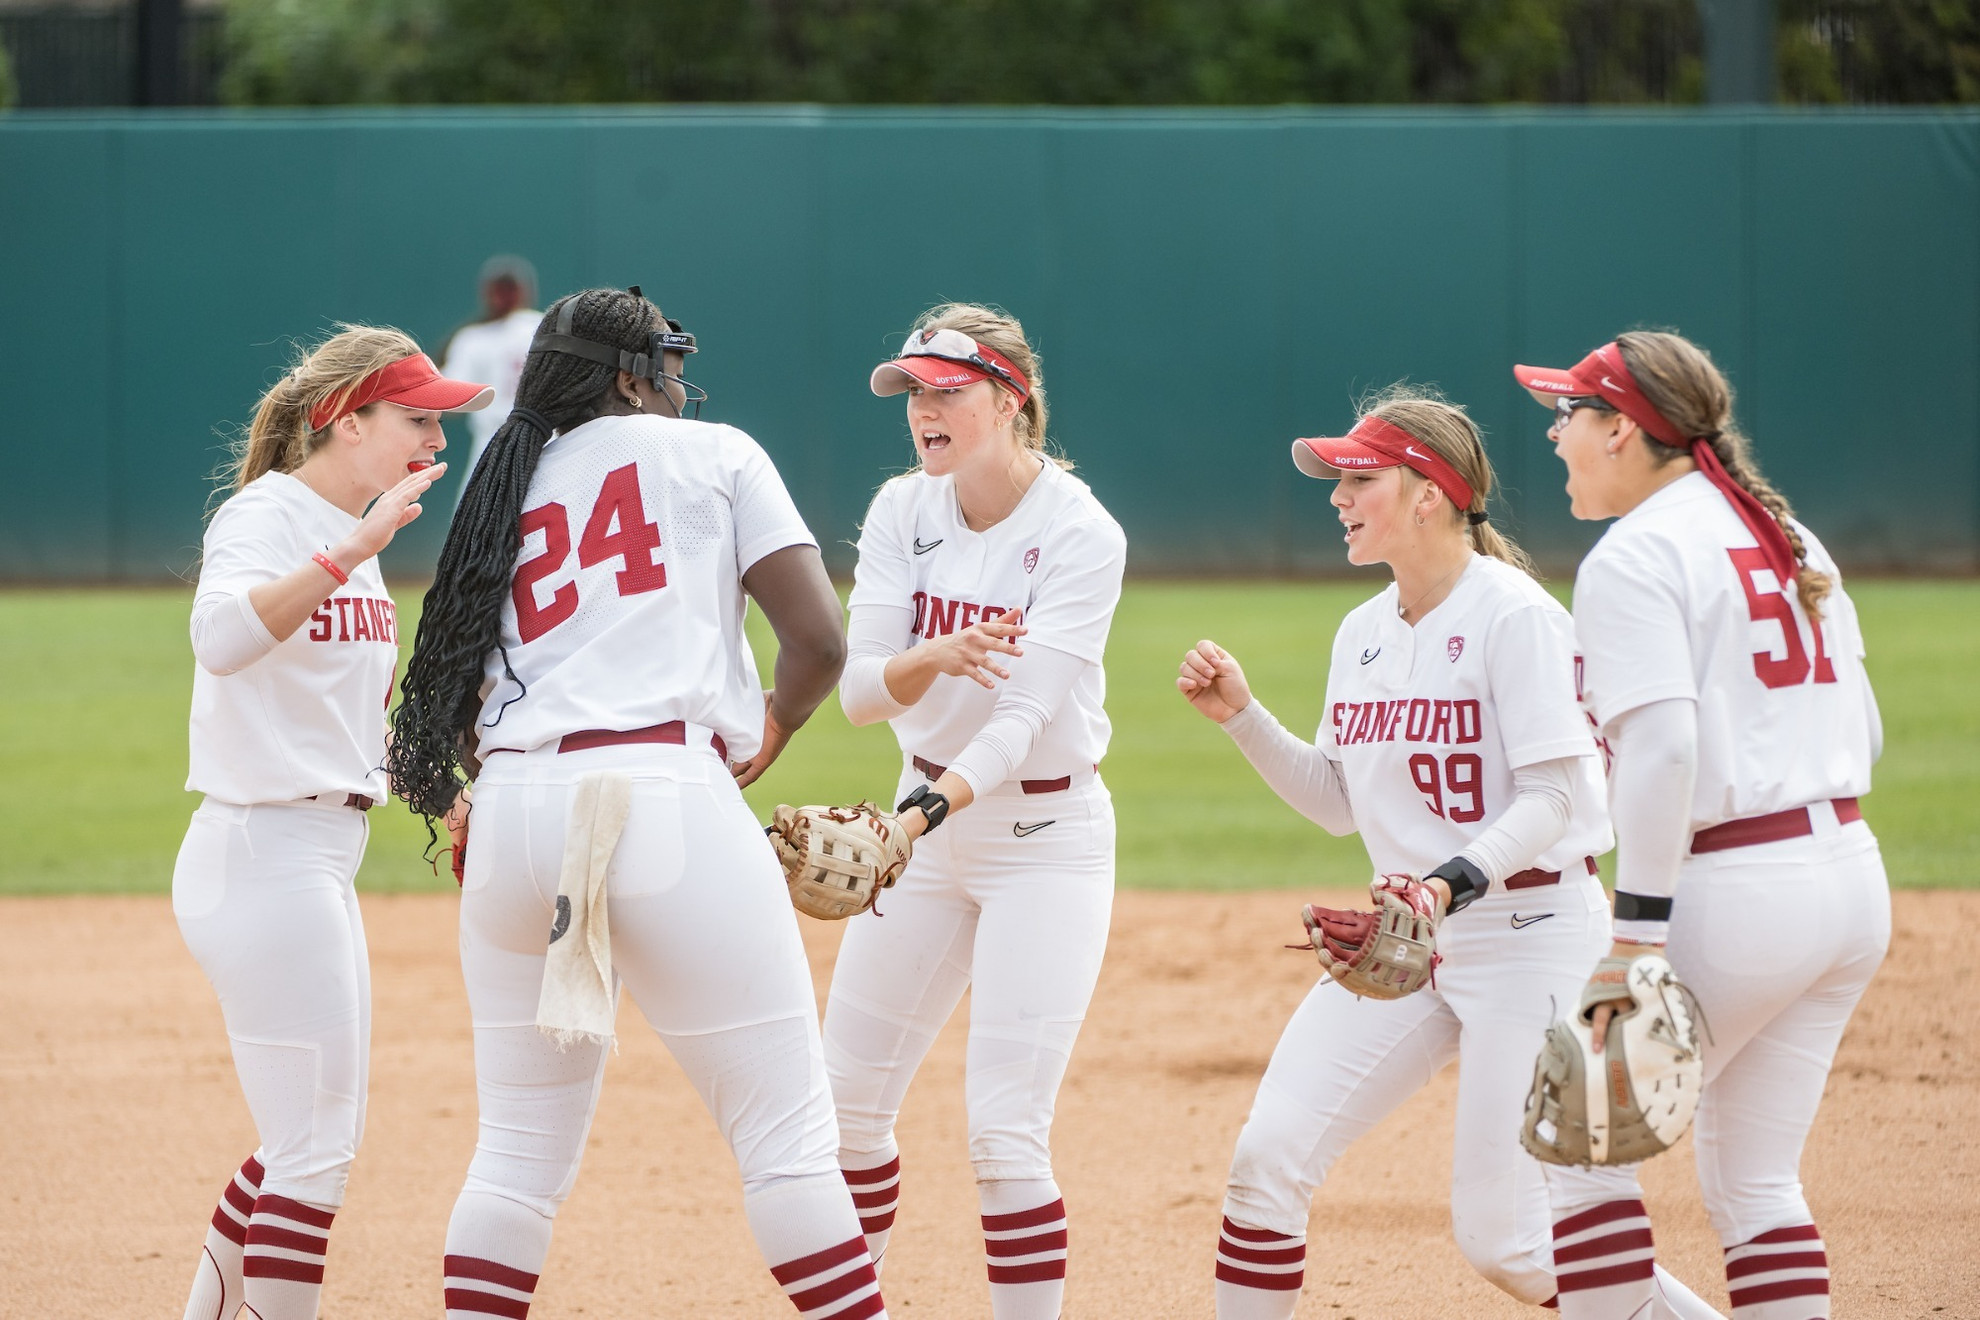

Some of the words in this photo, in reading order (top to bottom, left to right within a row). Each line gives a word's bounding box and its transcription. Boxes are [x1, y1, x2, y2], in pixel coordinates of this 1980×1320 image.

[935, 373, 972, 384] SOFTBALL
[1334, 457, 1379, 466] SOFTBALL
[511, 461, 667, 645] 24
[1333, 698, 1482, 746] STANFORD
[1408, 753, 1486, 824] 99
